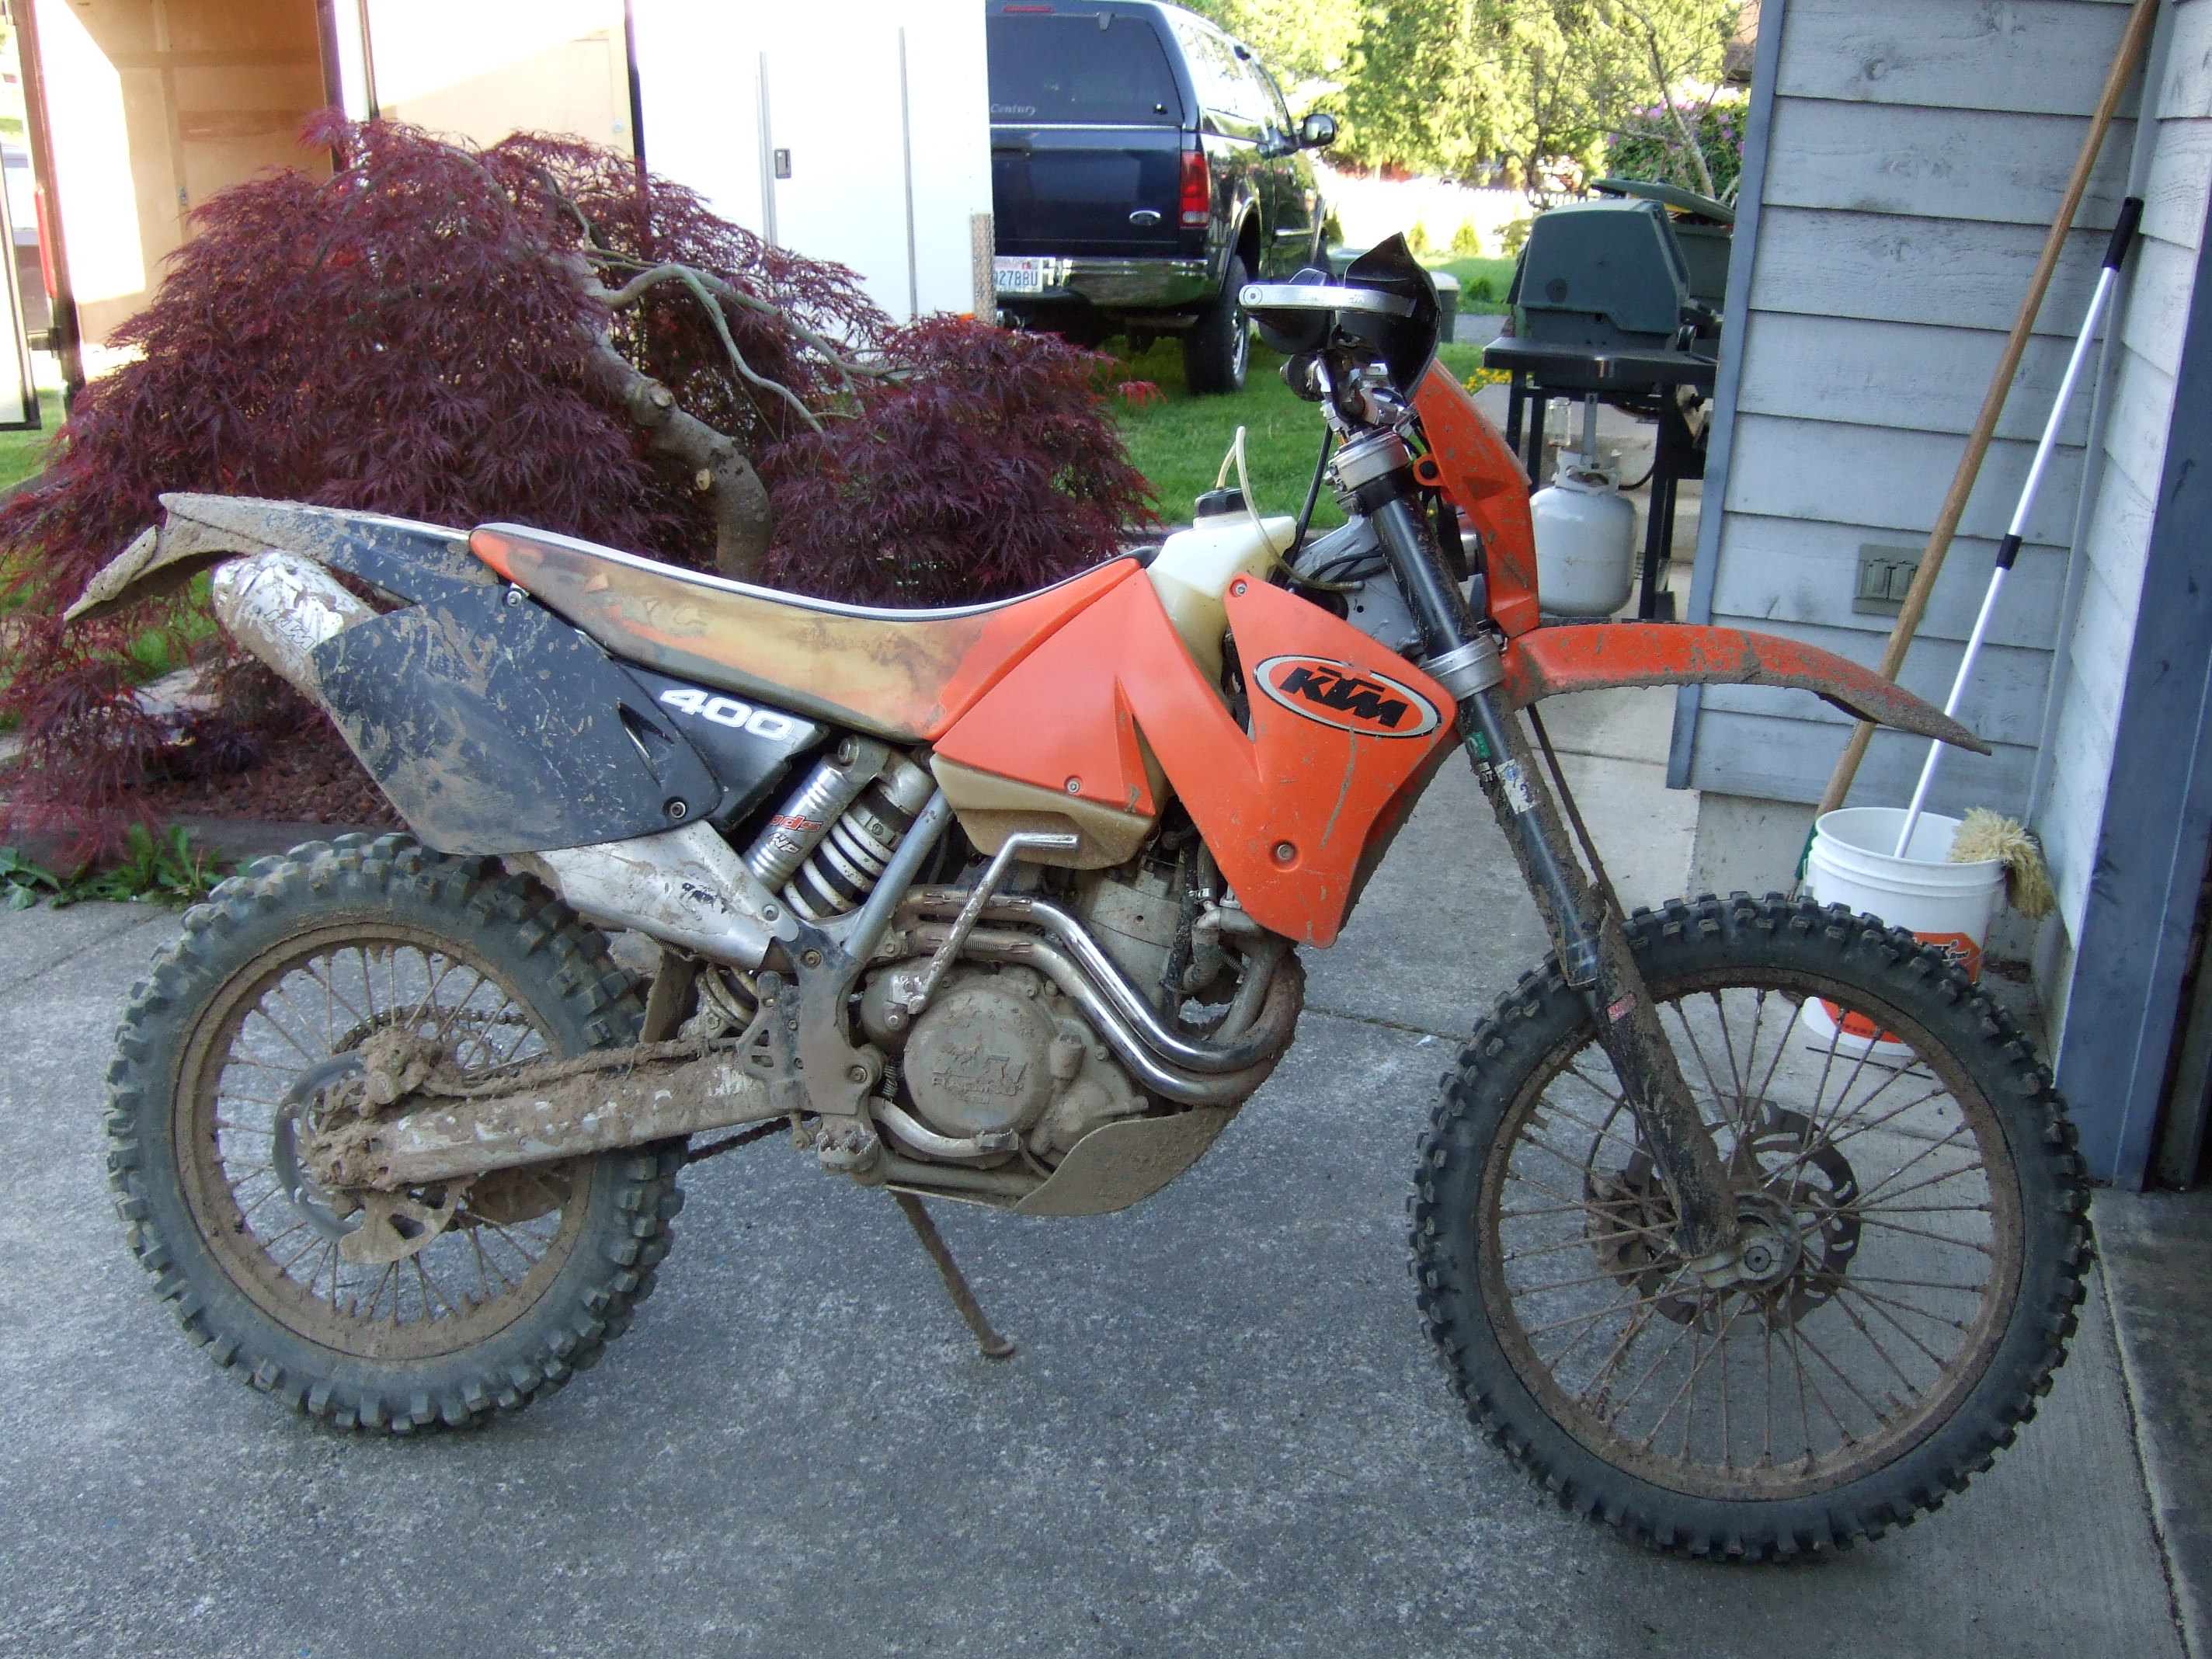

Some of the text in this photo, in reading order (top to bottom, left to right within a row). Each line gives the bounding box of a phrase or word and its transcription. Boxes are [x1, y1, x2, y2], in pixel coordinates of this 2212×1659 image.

[990, 103, 1036, 117] Century
[660, 689, 795, 741] 400
[1279, 666, 1408, 729] KTM
